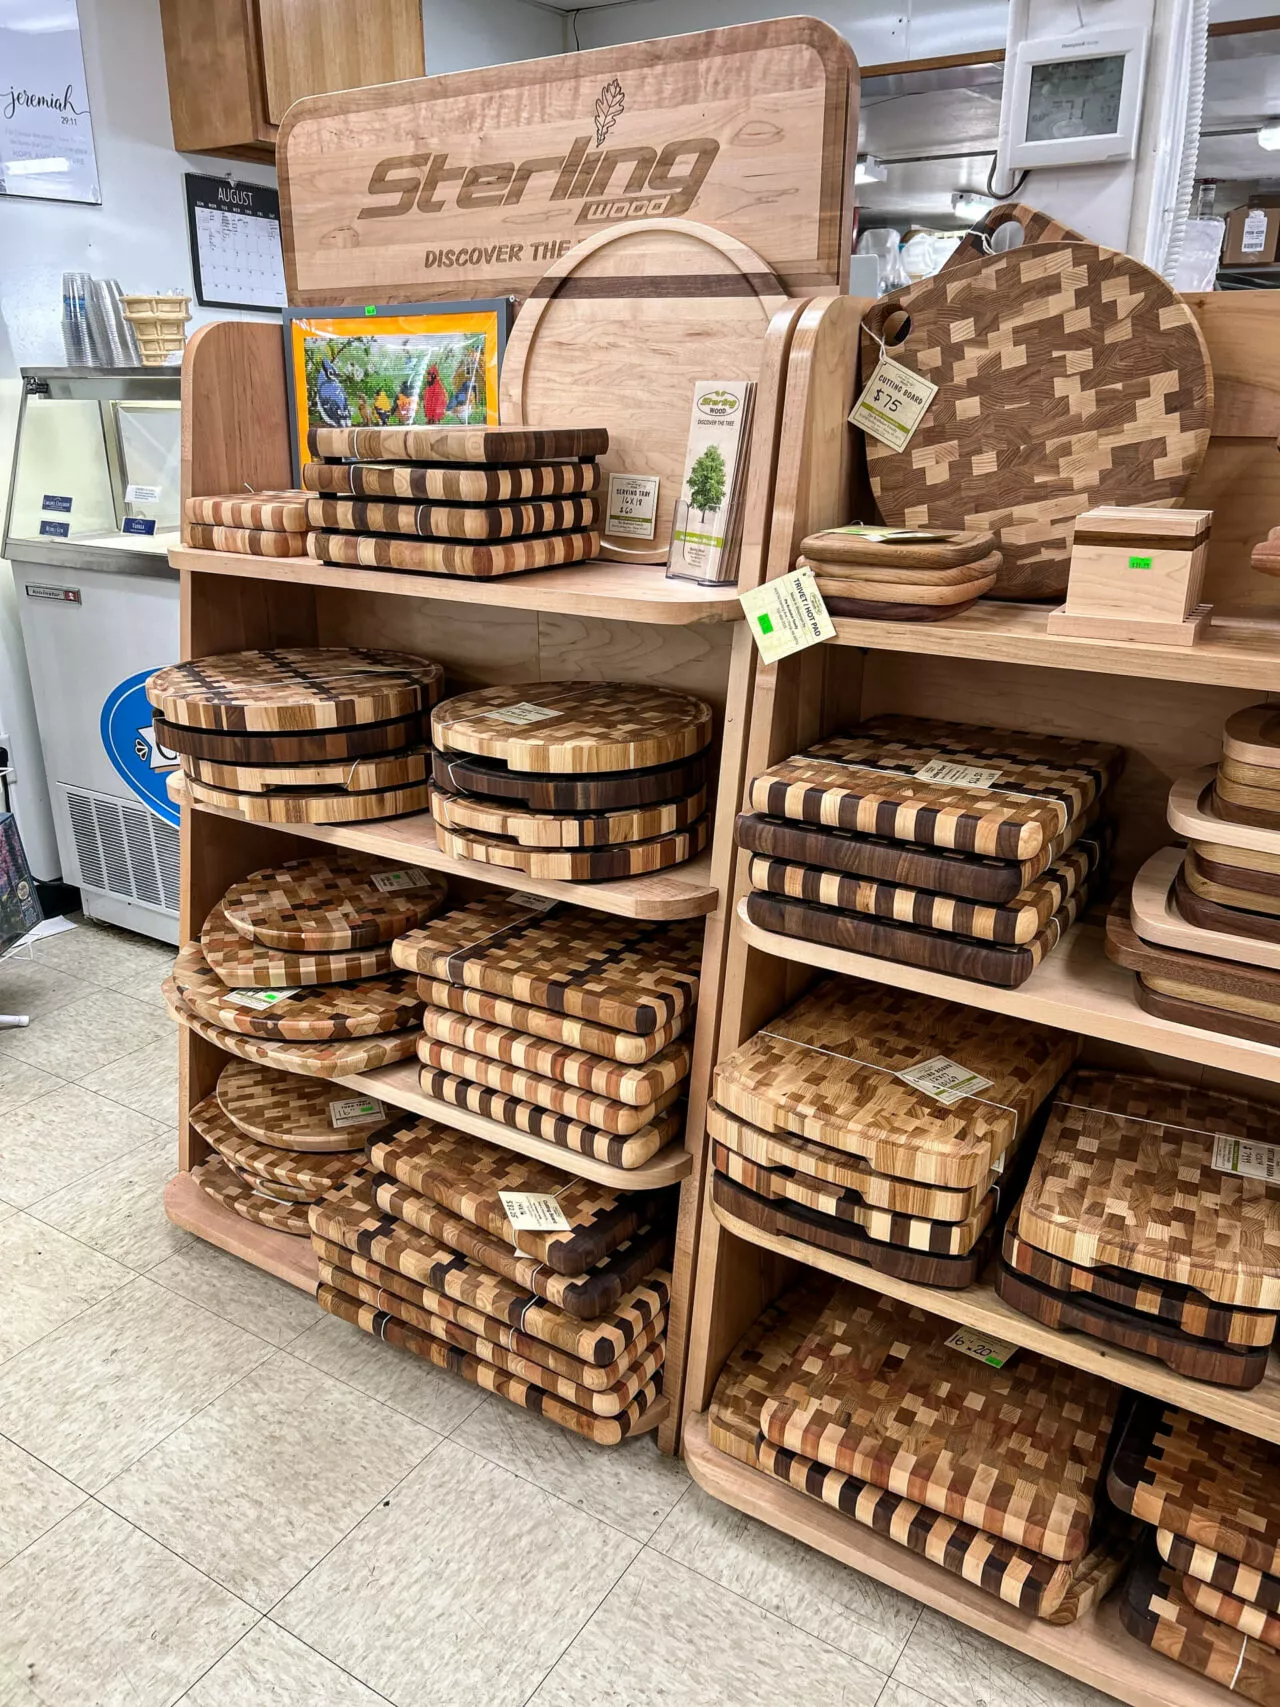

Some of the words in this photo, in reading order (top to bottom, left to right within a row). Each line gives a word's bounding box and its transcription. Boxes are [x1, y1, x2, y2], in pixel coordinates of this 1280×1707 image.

[0, 84, 91, 119] jeremiah
[357, 134, 720, 218] Sterling
[217, 186, 254, 207] AUGUST
[424, 243, 525, 269] DISCOVER
[530, 239, 571, 262] THE
[873, 387, 902, 412] $75
[878, 374, 903, 393] CUTTING
[902, 388, 923, 405] BOARD
[638, 490, 651, 498] TRAY
[793, 578, 808, 604] TRIVET
[804, 606, 815, 622] HOT
[811, 622, 821, 637] PAD
